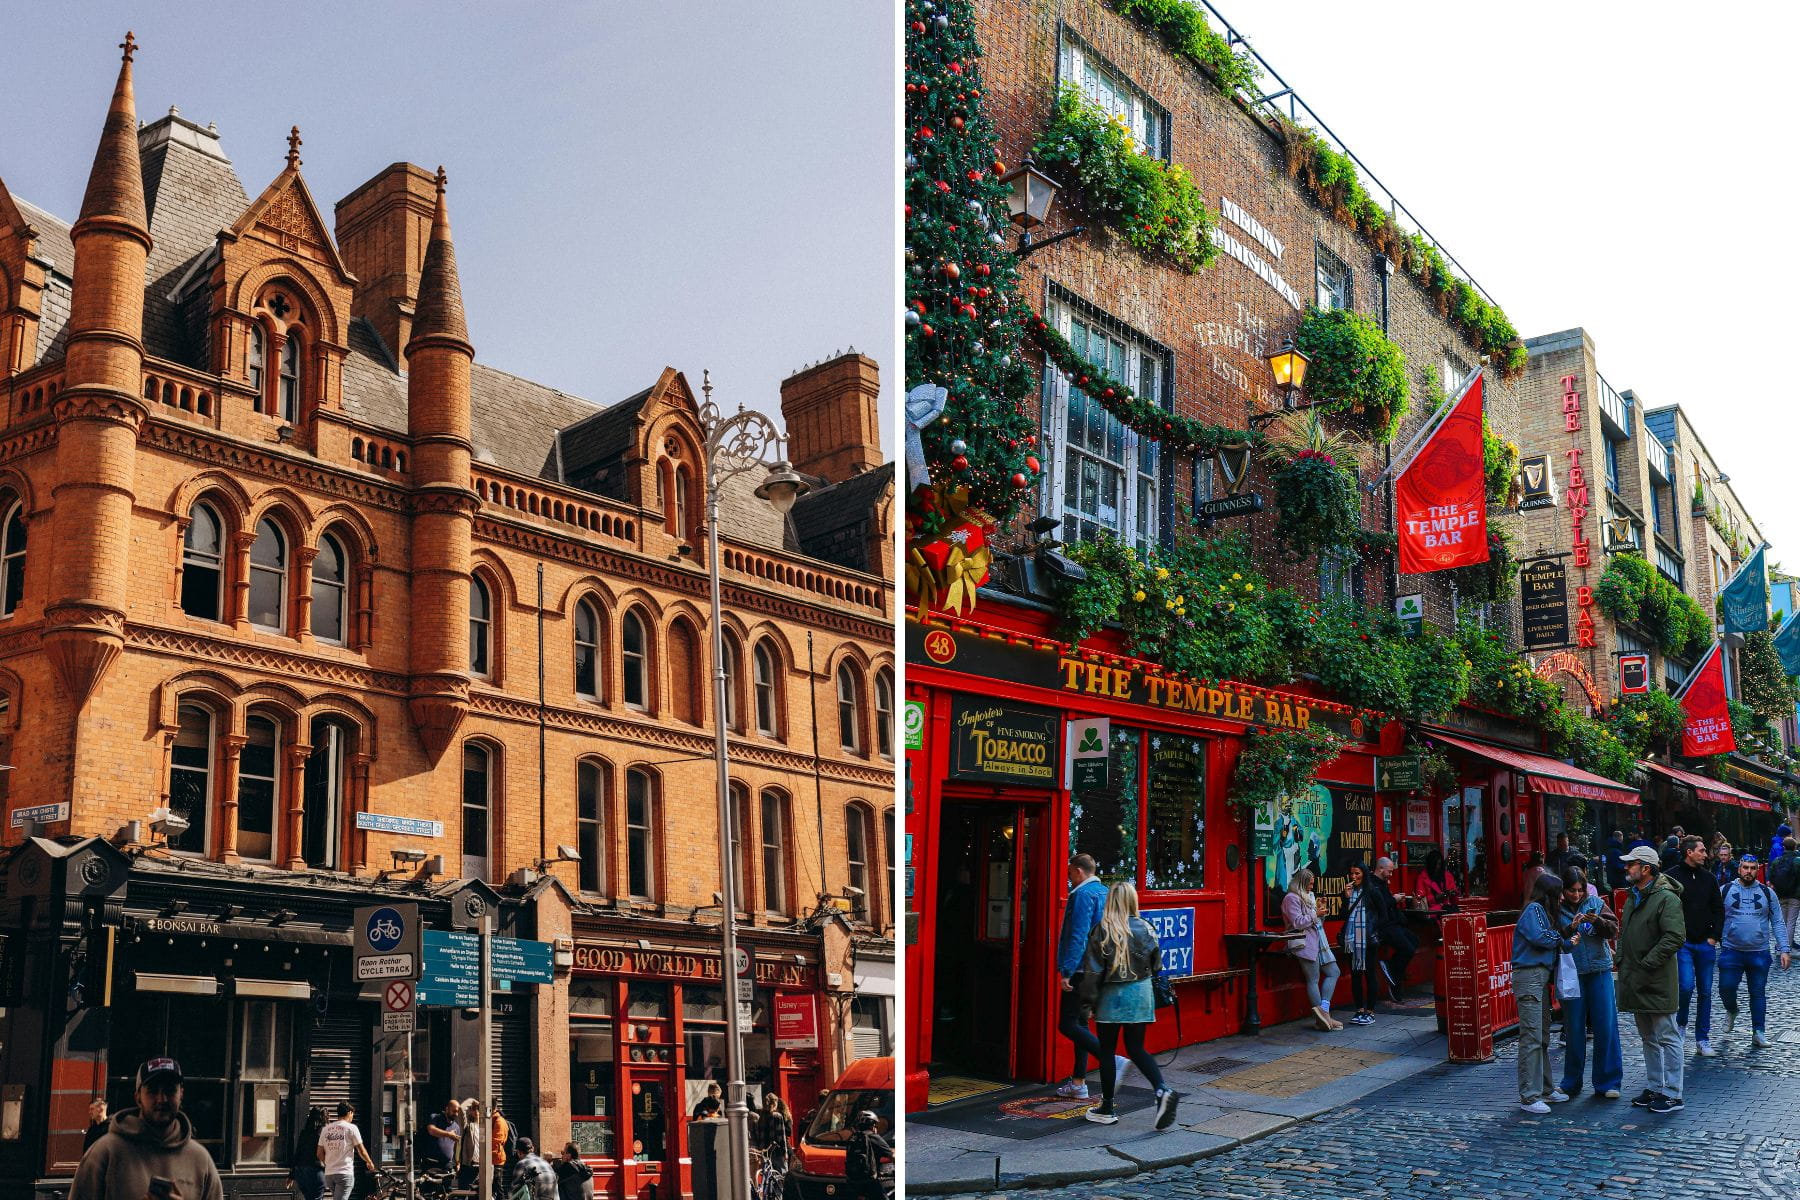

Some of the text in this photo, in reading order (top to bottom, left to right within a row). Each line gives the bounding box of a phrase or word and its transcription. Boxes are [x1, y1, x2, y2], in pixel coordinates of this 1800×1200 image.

[1220, 196, 1286, 260] MERRY
[1560, 374, 1581, 432] THE
[1205, 496, 1252, 514] GUINNESS
[1428, 504, 1459, 518] THE
[1521, 499, 1552, 508] GUINNESS
[1566, 449, 1591, 568] TEMPLE
[1406, 510, 1480, 535] TEMPLE
[1425, 531, 1463, 548] BAR
[1608, 543, 1636, 551] GUINNESS
[1523, 570, 1565, 583] TEMPLE
[1533, 582, 1556, 591] BAR
[1540, 602, 1564, 610] GARDEN
[1577, 586, 1598, 648] BAR
[1542, 623, 1564, 631] MUSIC
[1536, 631, 1557, 639] DAILY
[930, 635, 950, 656] 48
[1060, 658, 1311, 730] THE TEMPLE BAR
[958, 707, 1003, 729] Importers
[986, 720, 994, 728] OF
[1696, 718, 1714, 727] THE
[997, 727, 1046, 741] FINE SMOKING
[1685, 722, 1728, 737] TEMPLE
[1697, 733, 1719, 744] BAR
[970, 729, 1046, 767] TOBACCO
[1153, 750, 1184, 762] TEMPLE
[984, 760, 1052, 777] Always in Stock
[61, 807, 66, 816] 2
[1297, 801, 1328, 817] TEMPLE
[40, 813, 57, 822] STREET
[1304, 814, 1321, 830] BAR
[1358, 815, 1372, 832] THE
[1340, 831, 1373, 849] EMPEROR
[157, 919, 219, 934] BONSAI BAR
[379, 957, 402, 965] Rothar
[575, 947, 626, 969] GOOD
[633, 952, 697, 976] WORLD
[360, 965, 410, 976] CYCLE TRACK
[778, 1001, 798, 1009] Lisney
